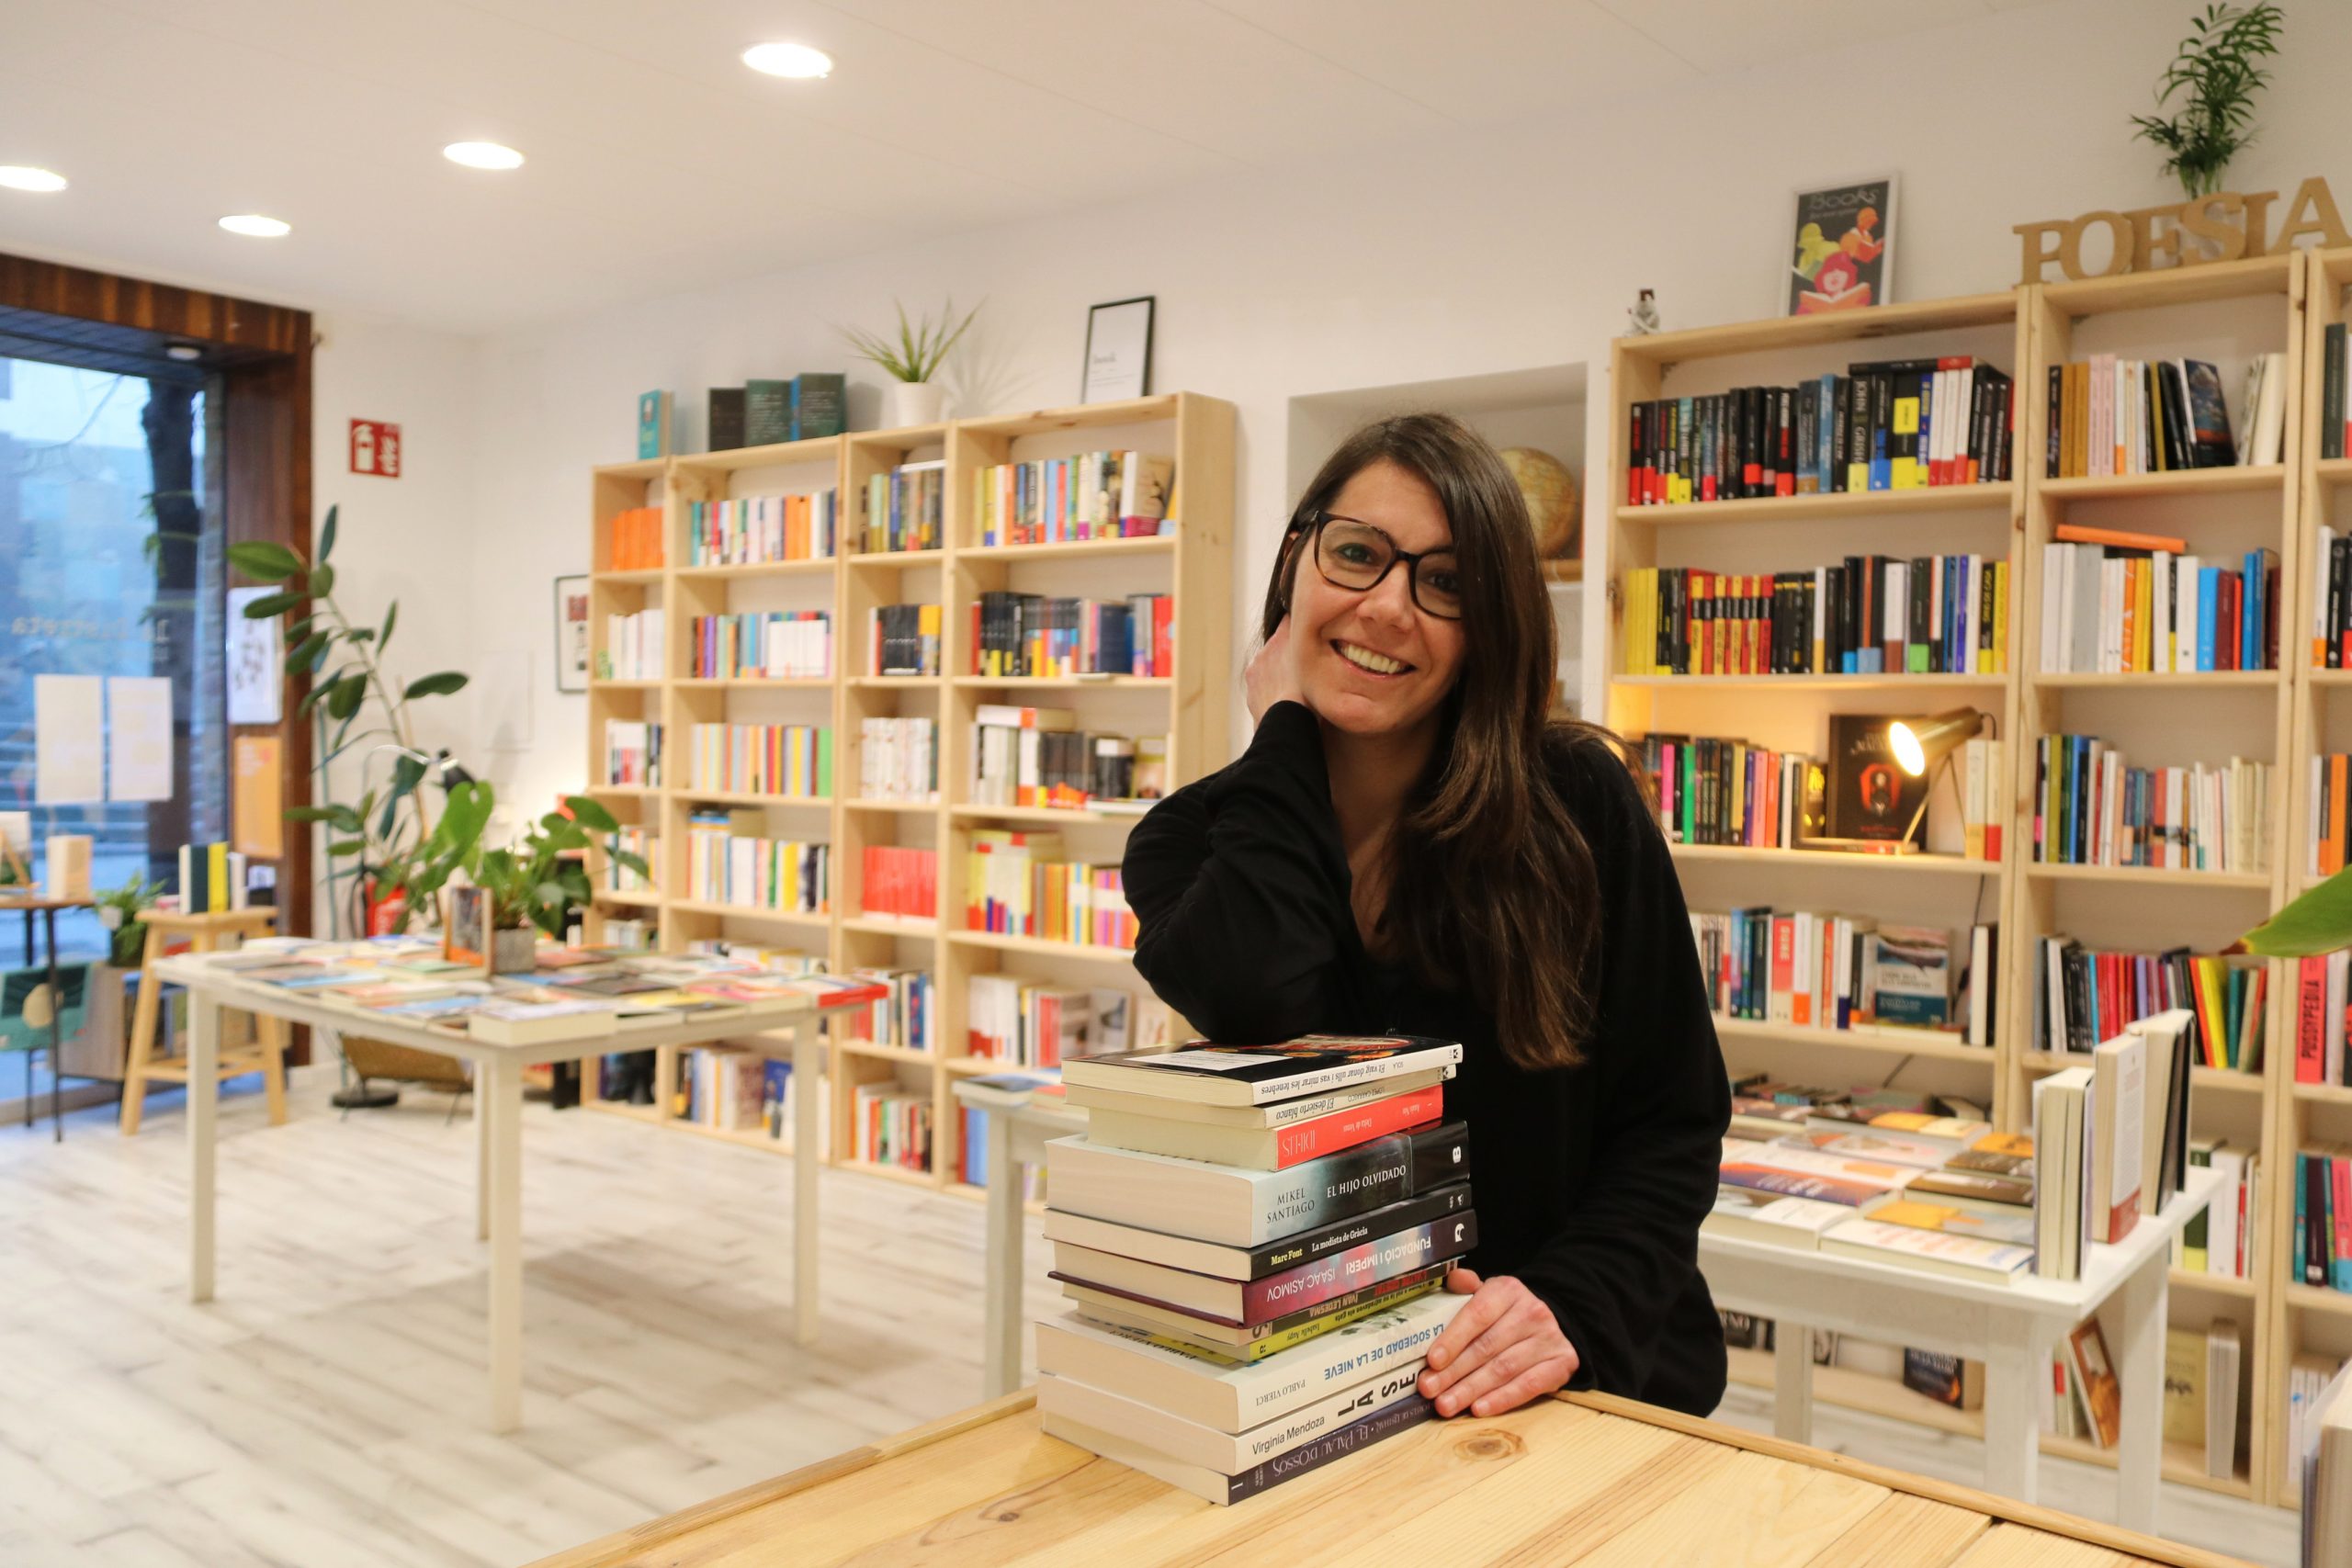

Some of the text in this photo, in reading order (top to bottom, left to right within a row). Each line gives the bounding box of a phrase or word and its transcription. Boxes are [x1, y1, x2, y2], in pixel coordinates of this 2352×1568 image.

[2013, 175, 2352, 289] POESIA
[1302, 1077, 1319, 1088] mirar
[1335, 1072, 1346, 1082] ulls
[1347, 1068, 1365, 1078] donar
[1365, 1066, 1377, 1077] vaig
[1261, 1082, 1290, 1095] tenebres
[1291, 1079, 1301, 1090] les
[1276, 1097, 1335, 1120] El desierto blanco
[1327, 1165, 1407, 1199] EL HIJO OLVIDADO
[1277, 1188, 1306, 1206] MIKEL
[1266, 1200, 1315, 1224] SANTIAGO
[1311, 1243, 1319, 1253] La
[1320, 1235, 1342, 1250] modista
[1342, 1232, 1350, 1242] de
[1385, 1235, 1431, 1265] FUNDACIÓ
[1271, 1248, 1303, 1266] Marc Font
[1346, 1253, 1378, 1276] IMPERI
[1266, 1267, 1336, 1303] ISAAC ASIMOV
[1324, 1323, 1444, 1380] LA SOCIEDAD DE LA NIEVE
[1256, 1379, 1306, 1406] PABLO VIERCI
[1338, 1367, 1427, 1416] LA SE
[1252, 1416, 1325, 1455] Virginia Mendoza
[1321, 1430, 1353, 1457] PALAU
[1356, 1424, 1368, 1440] EL
